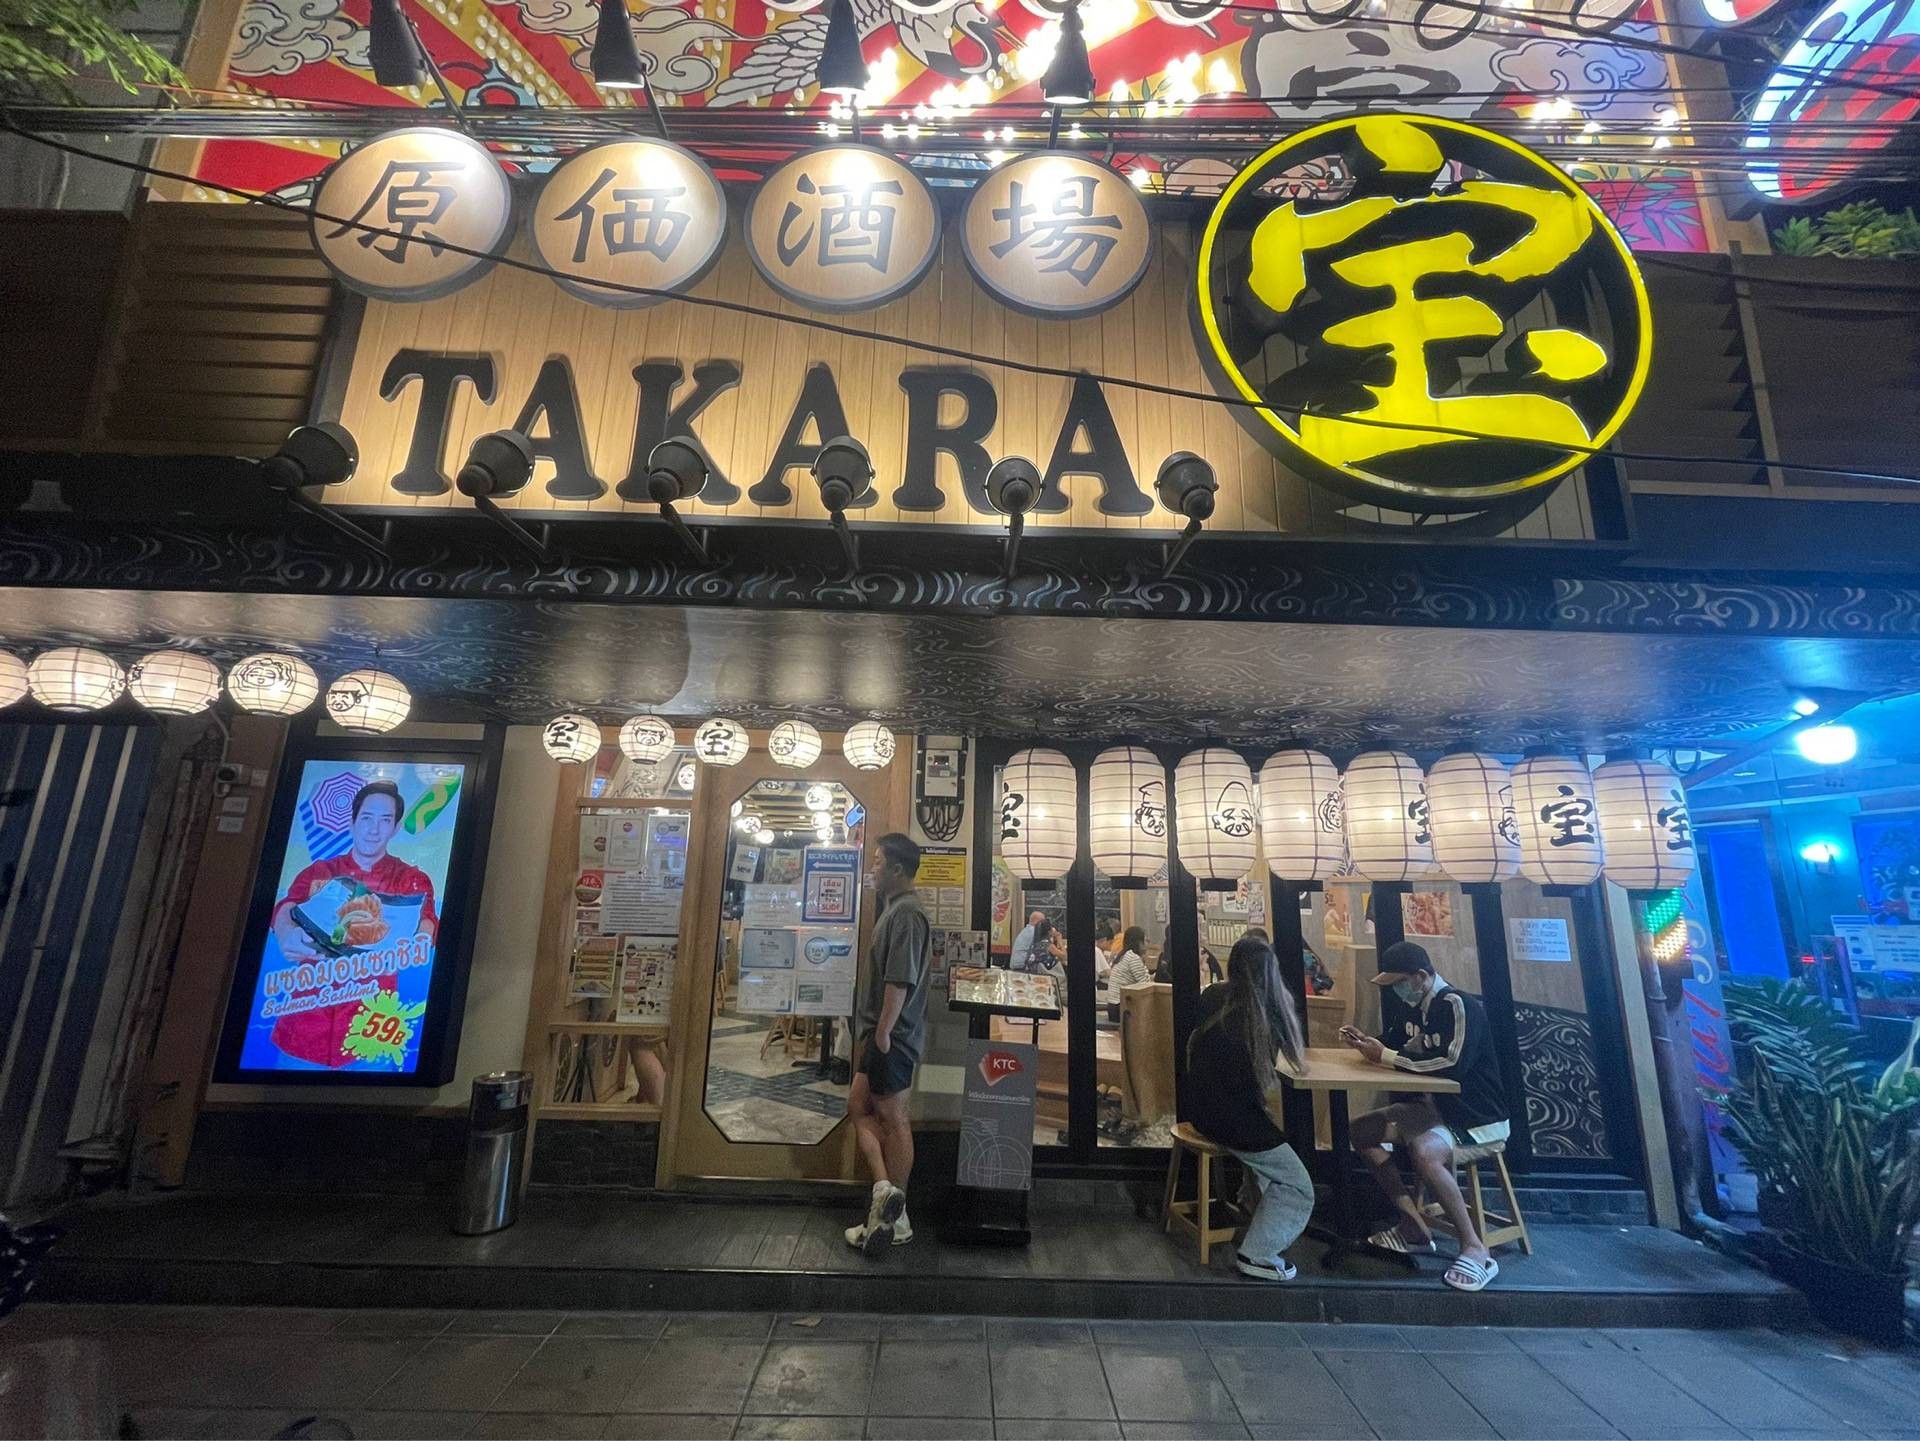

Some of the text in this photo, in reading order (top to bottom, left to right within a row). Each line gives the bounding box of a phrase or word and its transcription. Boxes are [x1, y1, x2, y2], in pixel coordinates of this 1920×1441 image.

[1247, 118, 1608, 467] 宝
[378, 348, 1154, 517] TAKARA
[701, 721, 731, 757] 宝
[1540, 785, 1595, 847] 宝
[262, 981, 379, 1018] Salmon Sashimi
[993, 1058, 1016, 1070] KTC
